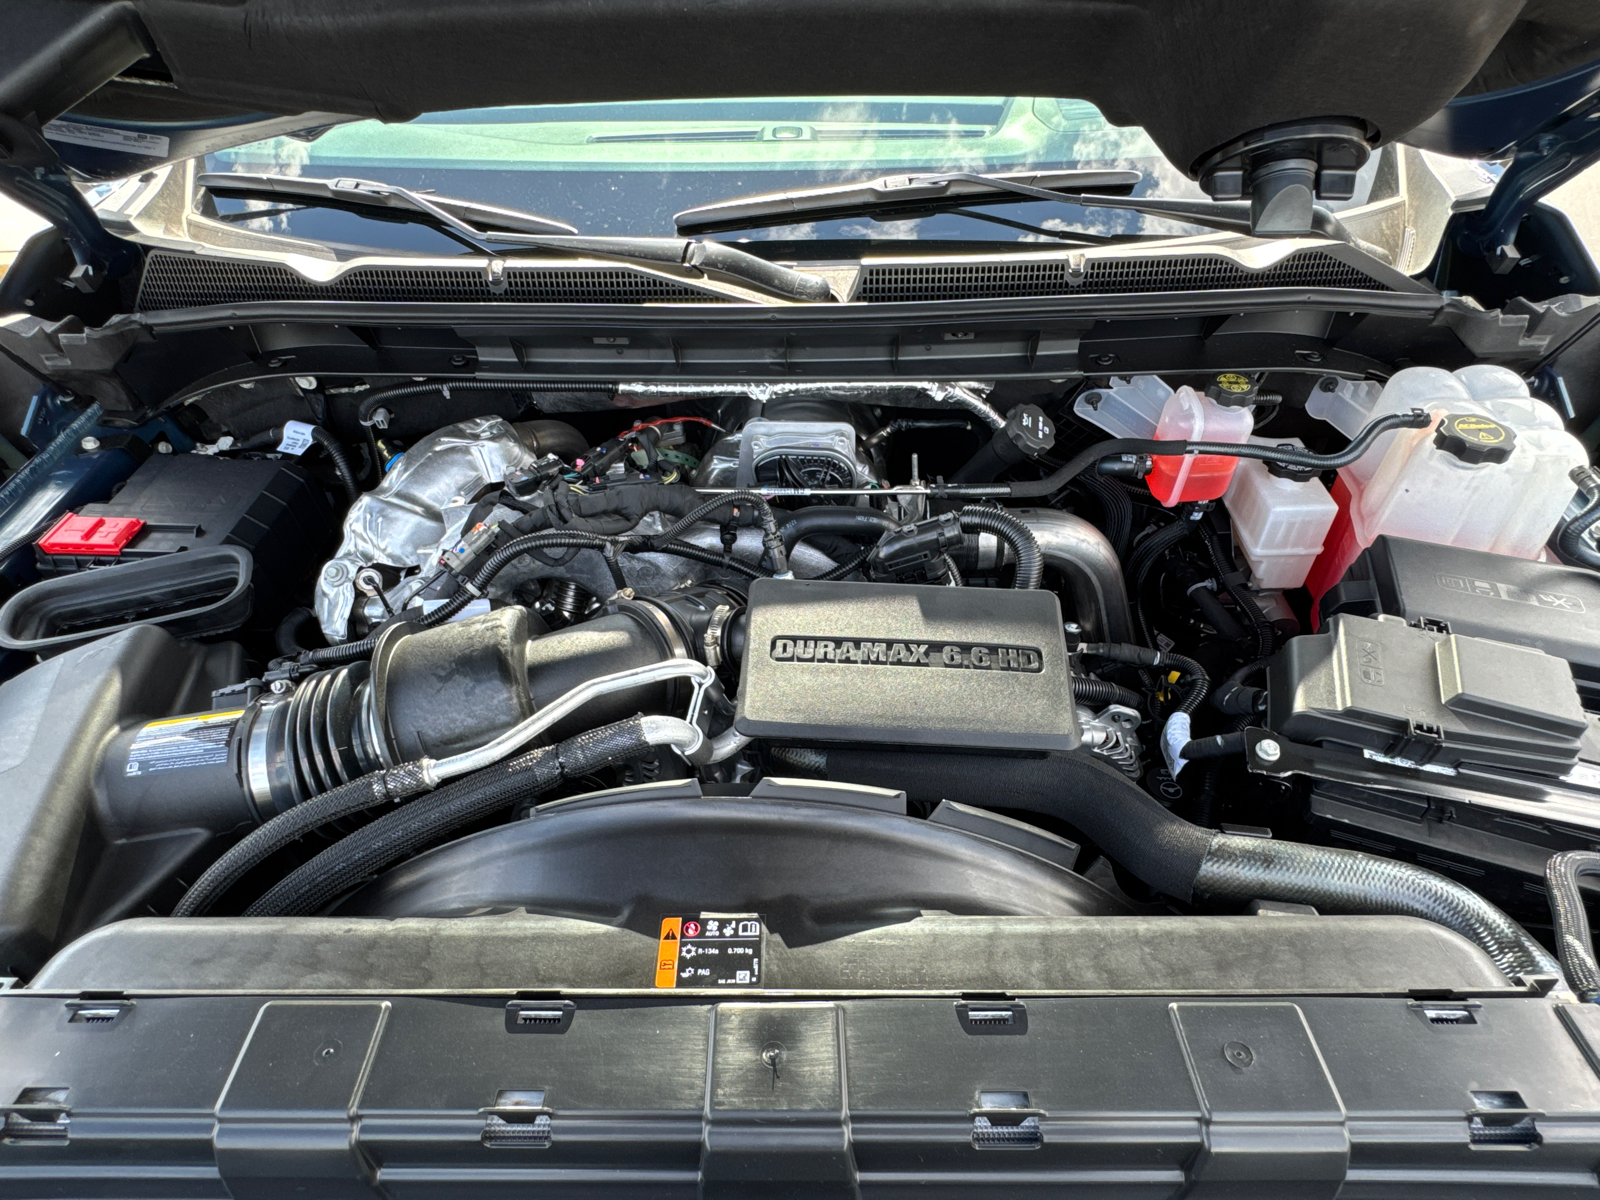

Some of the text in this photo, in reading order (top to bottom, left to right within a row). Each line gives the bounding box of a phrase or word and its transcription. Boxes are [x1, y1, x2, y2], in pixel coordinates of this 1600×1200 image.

[775, 639, 1039, 670] DURAMAX 6.6 HD
